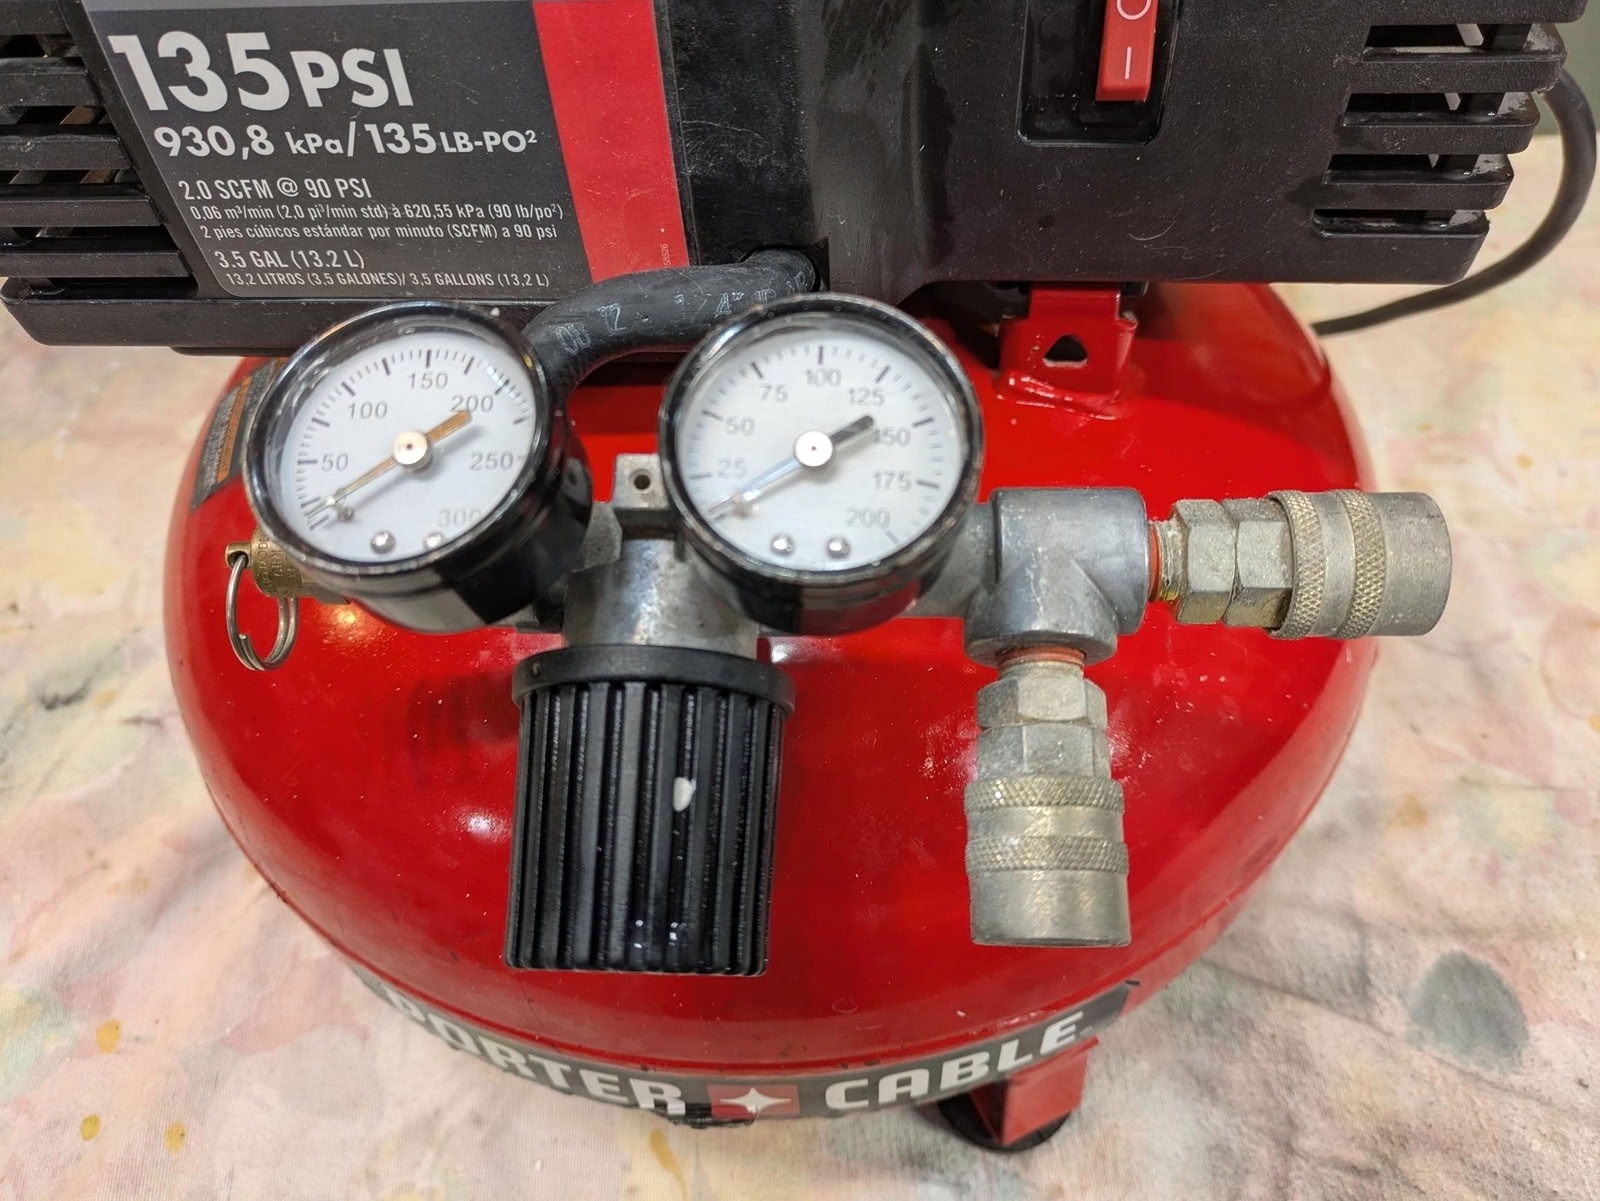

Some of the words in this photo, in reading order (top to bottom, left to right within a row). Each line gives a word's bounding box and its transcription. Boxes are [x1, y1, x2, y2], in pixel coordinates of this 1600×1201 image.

[107, 30, 290, 112] 135
[290, 48, 414, 108] PSI
[154, 124, 275, 160] 930,8
[364, 122, 437, 155] 135
[178, 180, 212, 200] 2.0
[214, 178, 274, 200] SCFM
[276, 177, 299, 197] @
[304, 178, 332, 199] 90
[334, 177, 372, 198] PSI
[190, 205, 222, 221] 0,06
[276, 203, 305, 220] (2,0
[360, 204, 389, 219] std)
[392, 203, 402, 218] à
[403, 203, 453, 220] 620,55
[455, 203, 485, 218] kPa
[488, 203, 512, 219] (90
[200, 225, 212, 239] 2
[213, 225, 244, 241] pies
[246, 224, 301, 239] cúbicos
[303, 223, 364, 238] estándar
[368, 227, 391, 240] por
[395, 223, 444, 238] minuto
[447, 223, 498, 239] (SCFM)
[502, 227, 511, 238] a
[513, 224, 532, 238] 90
[536, 224, 558, 240] psi
[214, 250, 247, 269] 3.5
[249, 250, 289, 268] GAL
[290, 249, 342, 269] (13.2
[344, 249, 365, 269] L)
[226, 272, 259, 287] 13,2
[257, 272, 305, 286] LITROS
[306, 272, 334, 287] (3,5
[409, 272, 432, 286] 3,5
[434, 272, 495, 286] GALLONS
[497, 272, 533, 287] (13,2
[535, 272, 549, 287] L)
[408, 373, 448, 390] 150
[806, 369, 841, 387] 100
[761, 384, 788, 402] 75
[849, 387, 884, 406] 125
[347, 402, 388, 420] 100
[451, 394, 494, 413] 200
[725, 419, 755, 436] 50
[874, 428, 911, 447] 150
[321, 454, 349, 472] 50
[469, 454, 513, 471] 250
[717, 459, 748, 479] 25
[874, 471, 911, 489] 175
[846, 509, 890, 528] 200
[381, 984, 686, 1116] PORTER
[825, 1010, 1084, 1111] CABLE
